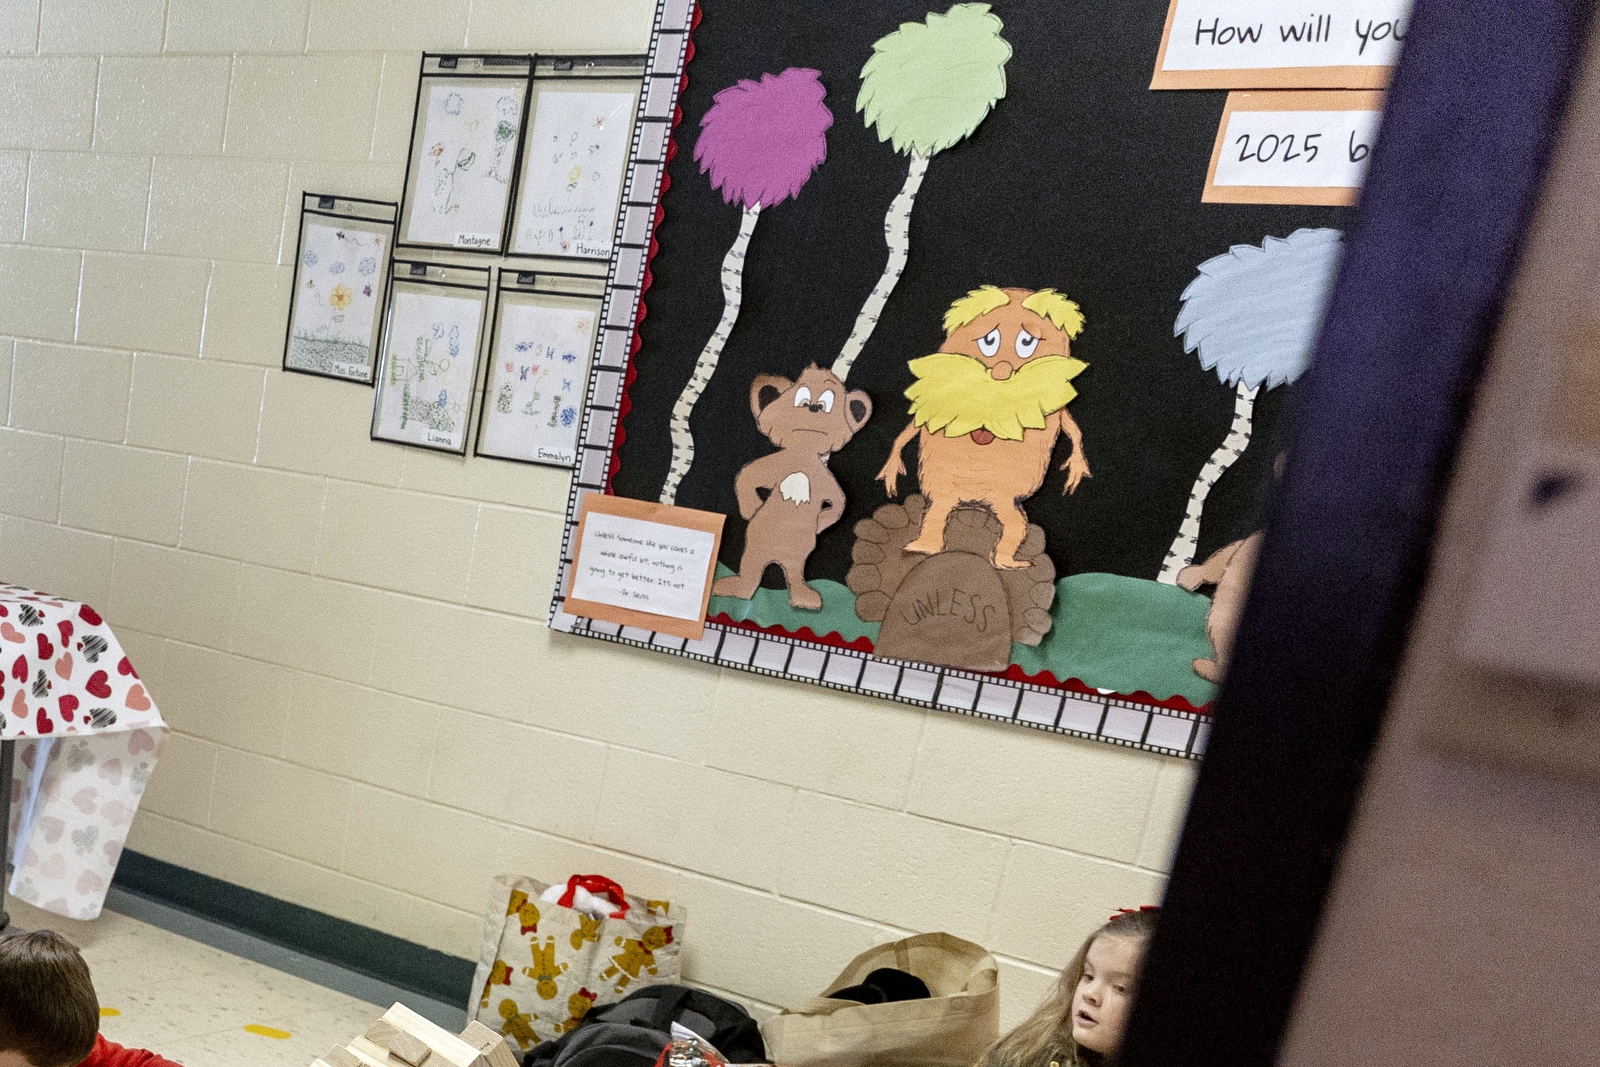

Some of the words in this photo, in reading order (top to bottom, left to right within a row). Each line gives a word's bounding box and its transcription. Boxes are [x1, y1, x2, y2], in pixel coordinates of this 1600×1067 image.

[1195, 18, 1263, 46] How
[1280, 14, 1331, 43] will
[1235, 134, 1321, 163] 2025
[576, 242, 610, 256] Harrison
[658, 543, 669, 551] you
[608, 568, 616, 576] to
[617, 571, 629, 582] get
[902, 588, 996, 632] UNLESS
